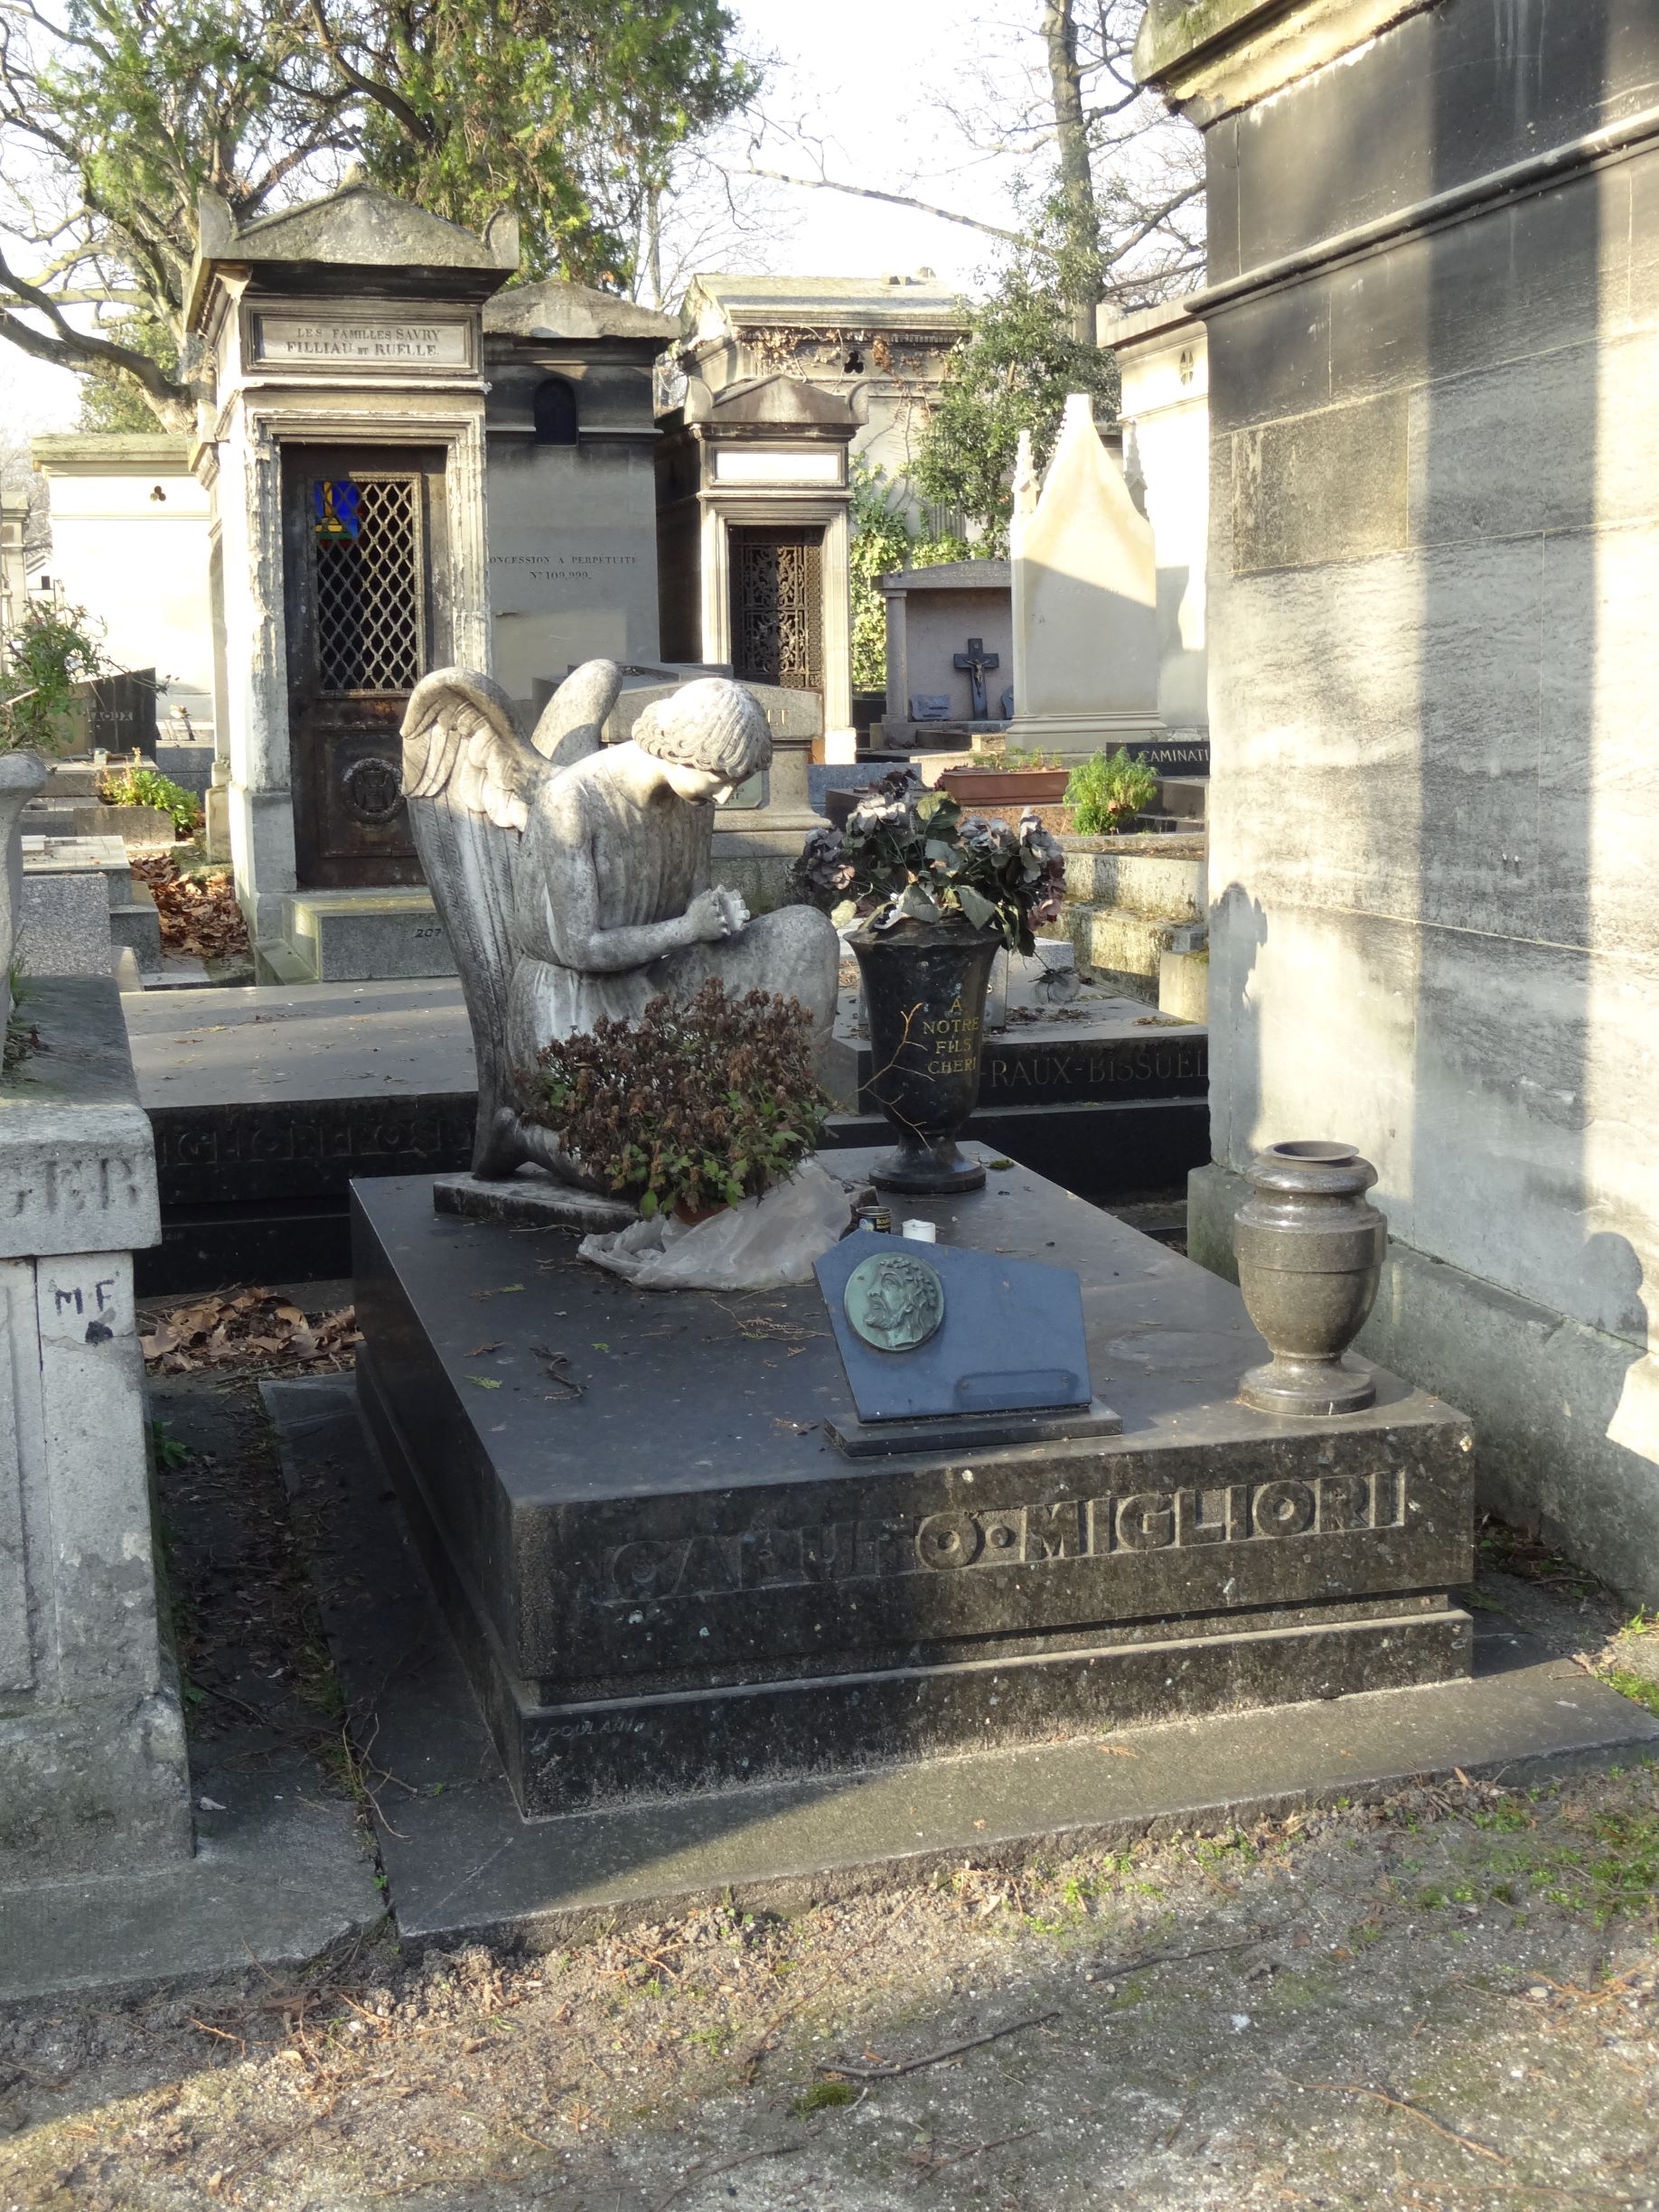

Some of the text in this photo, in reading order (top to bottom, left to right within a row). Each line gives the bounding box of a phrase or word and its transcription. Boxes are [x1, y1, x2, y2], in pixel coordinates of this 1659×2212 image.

[297, 328, 323, 339] LES
[333, 329, 391, 342] FAMILLES
[286, 341, 352, 355] FILLIAU
[490, 556, 550, 565] ONCESSION
[766, 708, 791, 726] LT
[922, 1017, 979, 1035] NOTRE
[935, 1038, 972, 1054] FILS
